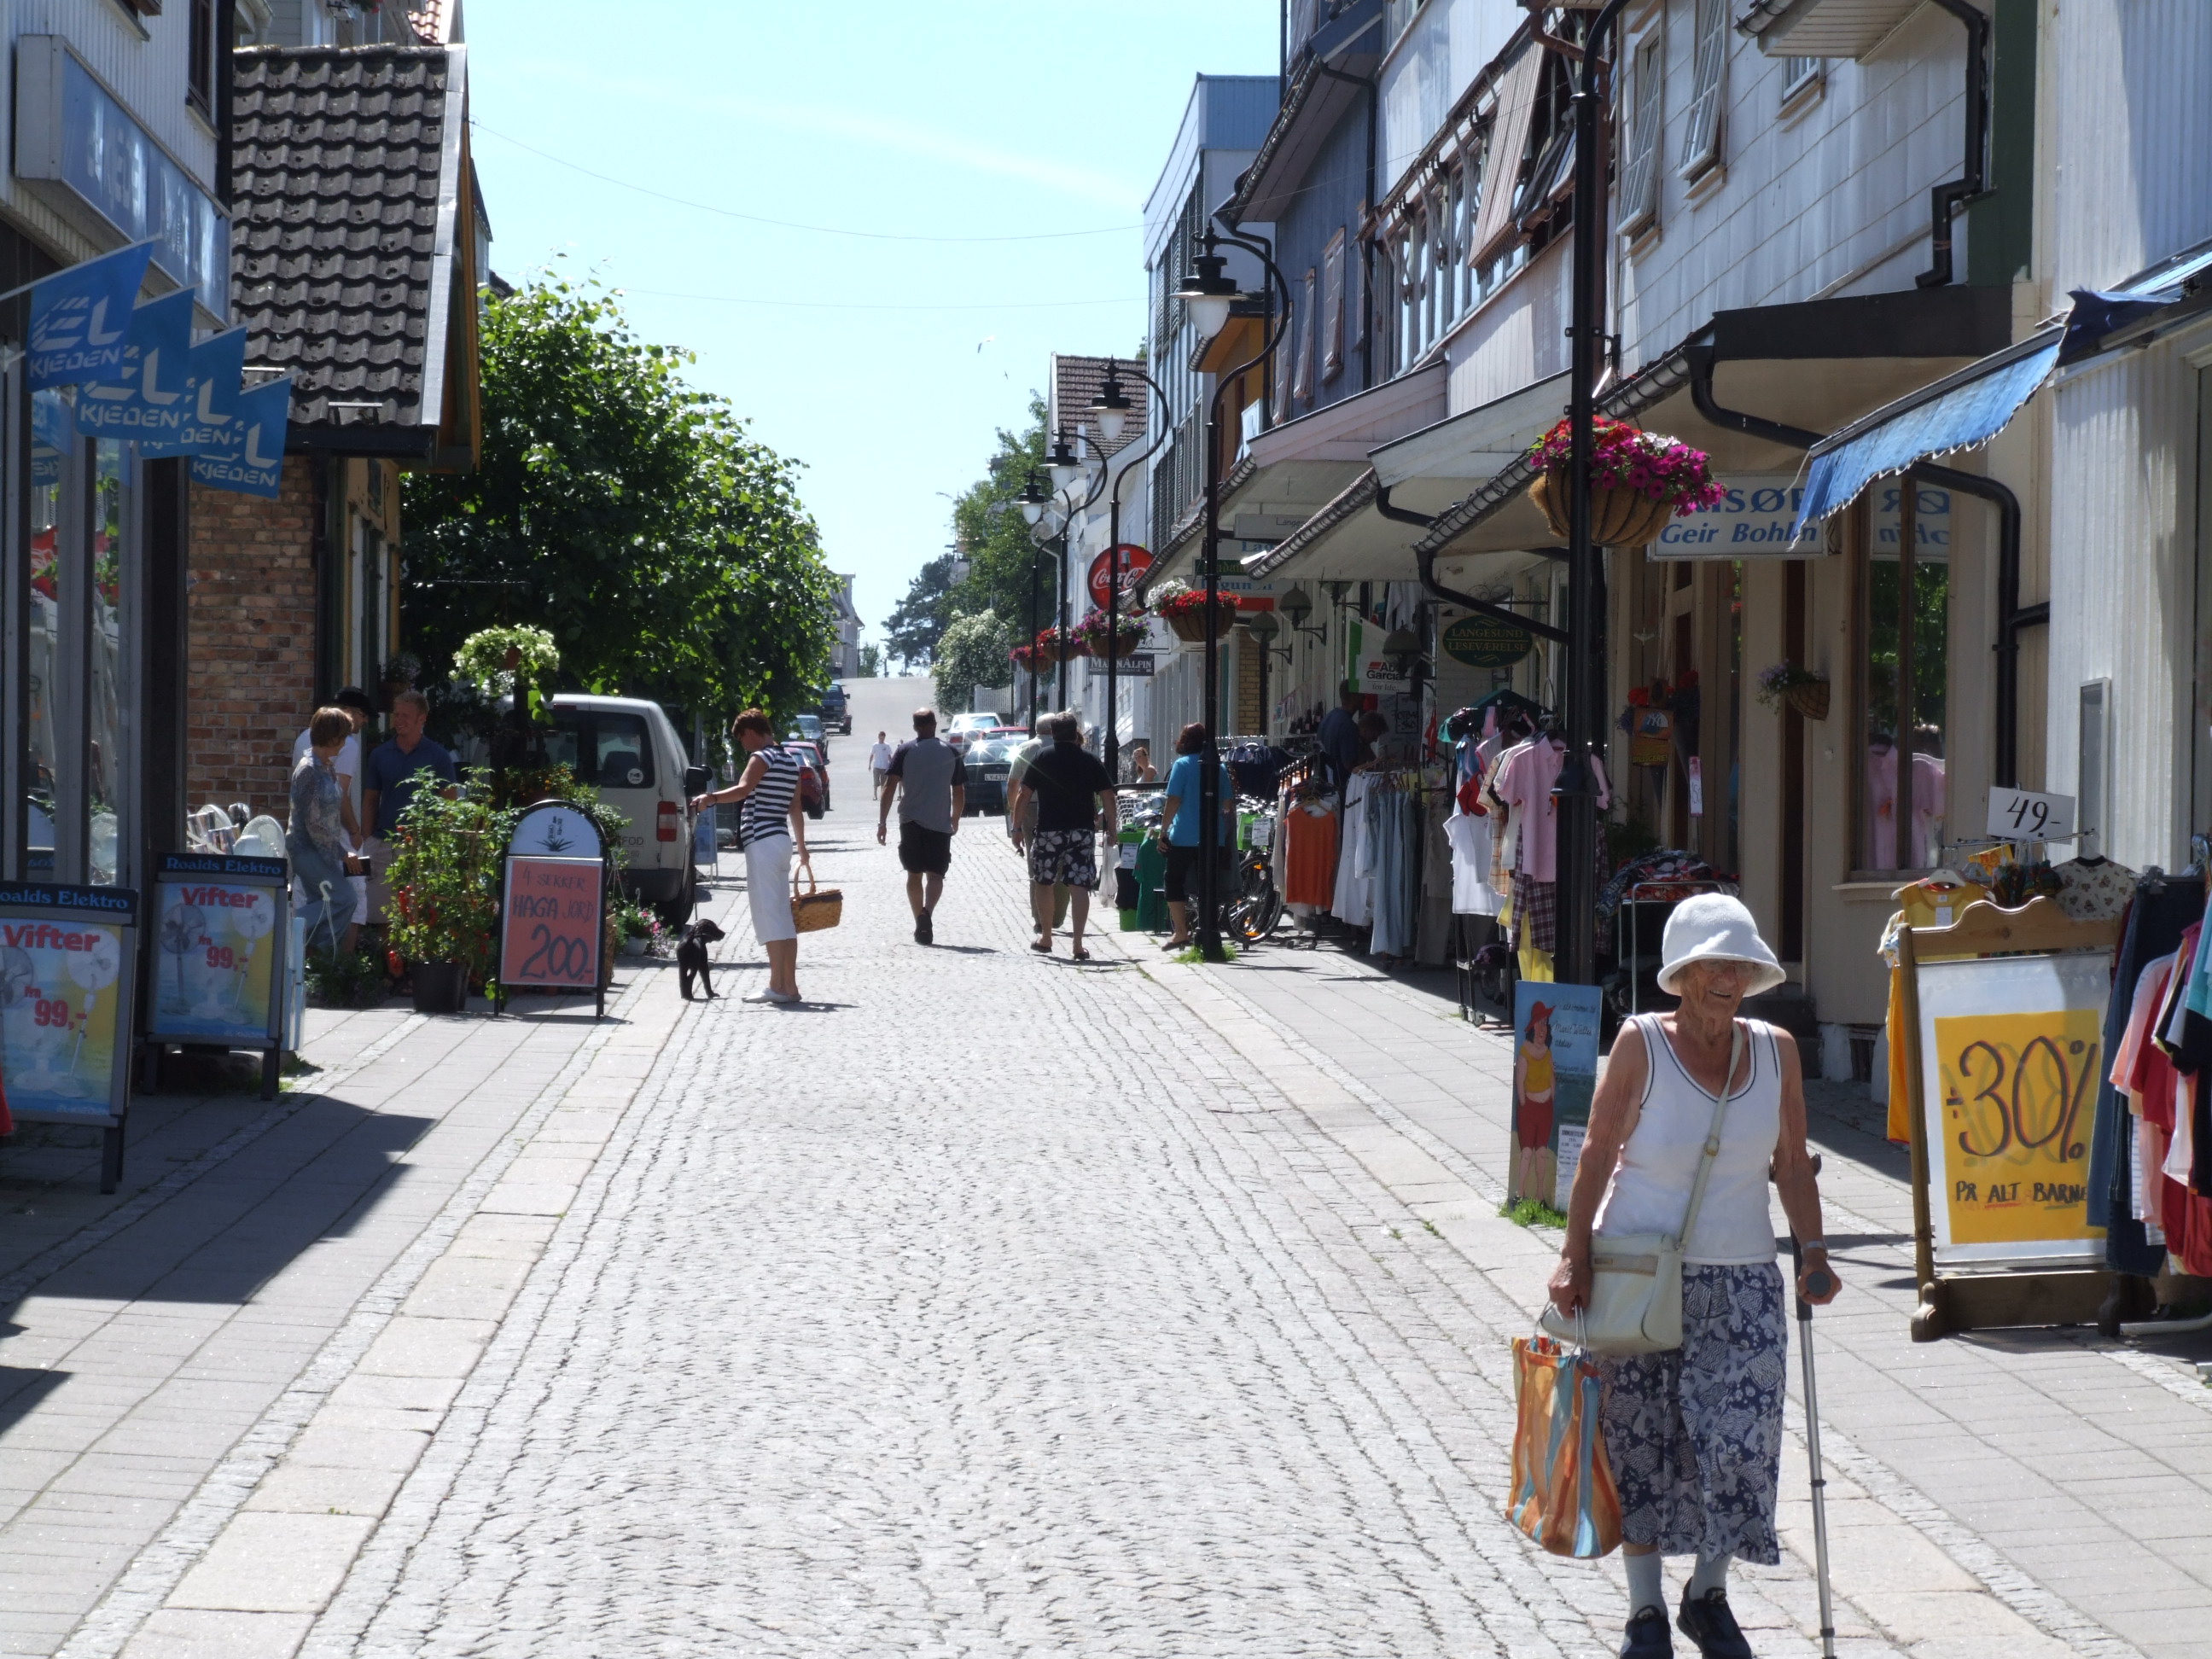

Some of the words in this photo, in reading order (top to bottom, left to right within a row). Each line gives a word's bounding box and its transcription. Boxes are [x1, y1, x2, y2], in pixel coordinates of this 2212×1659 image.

[31, 294, 125, 352] EL
[29, 347, 120, 379] KJEDEN
[80, 403, 179, 428] KJEDEN
[193, 460, 276, 486] KJEDEN
[1660, 522, 1719, 544] Geir
[1731, 521, 1817, 543] Bohln
[1452, 628, 1523, 637] LANGESUND
[1448, 642, 1527, 652] LESEVÆRELSE
[166, 858, 219, 870] Roalds
[224, 859, 281, 875] Elektro
[523, 865, 531, 886] 4
[537, 873, 586, 892] SEKKER
[0, 889, 52, 904] oalds
[57, 890, 128, 909] Elektro
[181, 888, 259, 909] Vifter
[562, 899, 594, 923] JORD
[3, 924, 101, 952] Vifter
[34, 999, 87, 1030] 99,-
[1987, 1182, 2022, 1202] ALT
